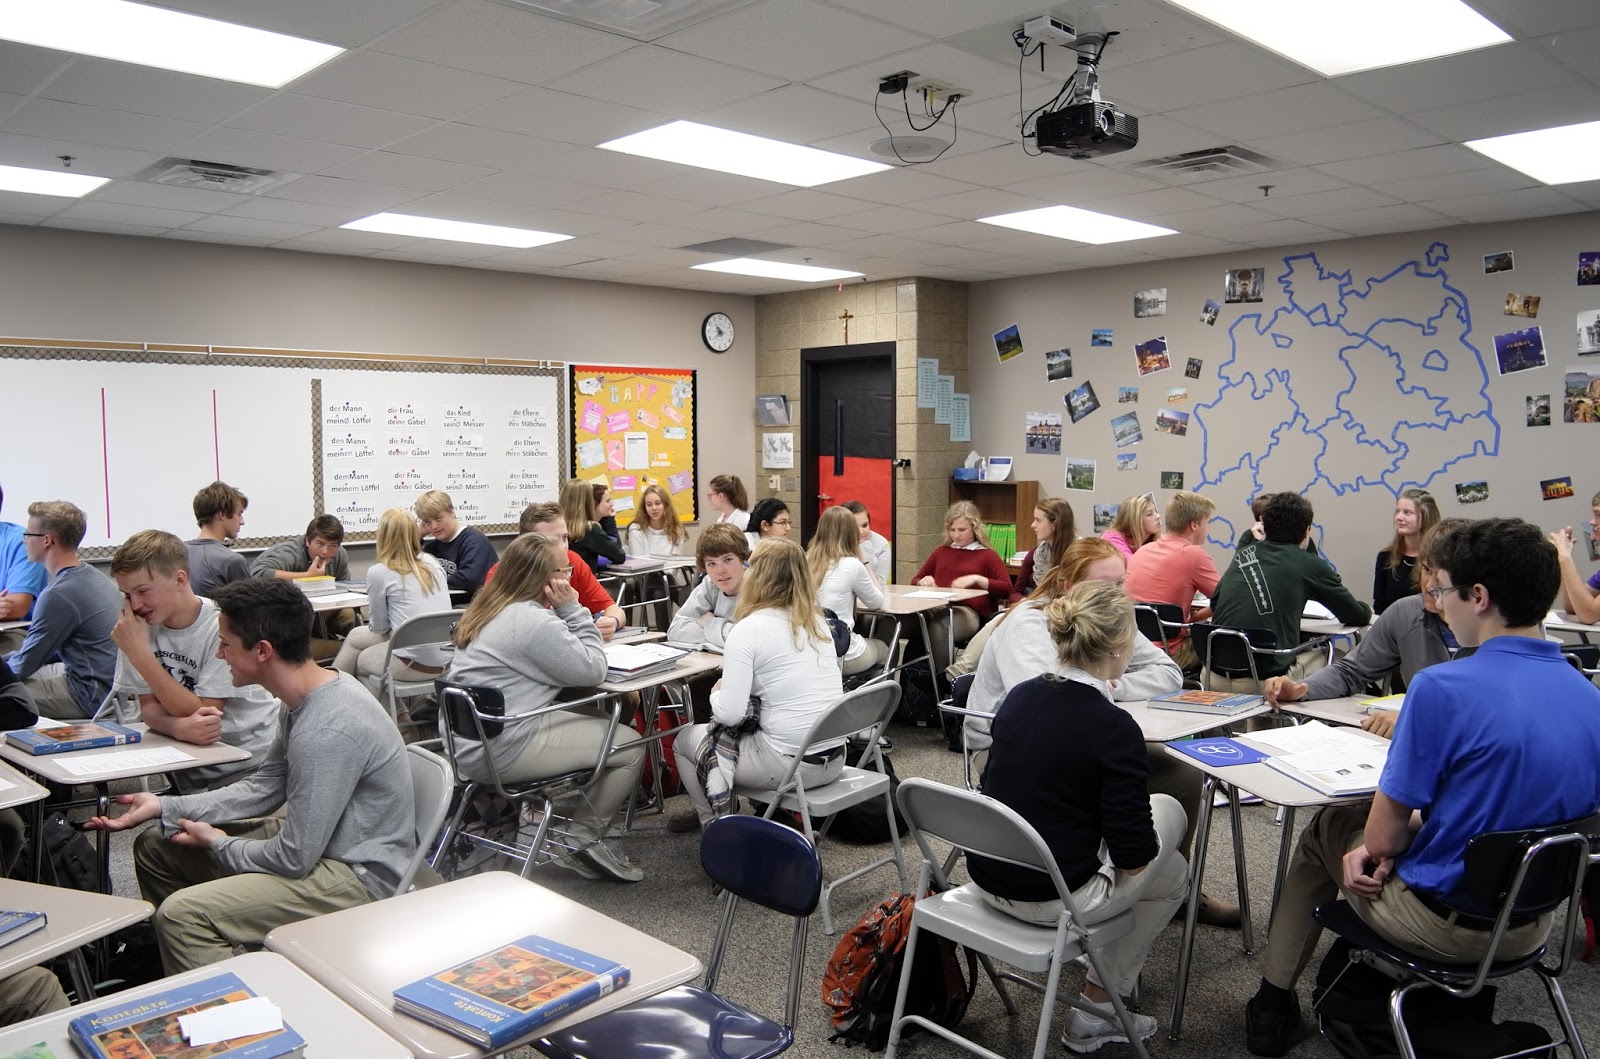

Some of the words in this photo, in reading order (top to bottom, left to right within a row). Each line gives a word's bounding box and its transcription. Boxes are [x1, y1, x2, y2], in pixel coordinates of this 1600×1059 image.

[90, 1000, 168, 1026] Kontakte
[102, 1008, 157, 1027] Communicative
[160, 997, 193, 1010] Approach
[454, 1000, 504, 1023] Kontakte
[544, 1002, 570, 1017] Kontakte
